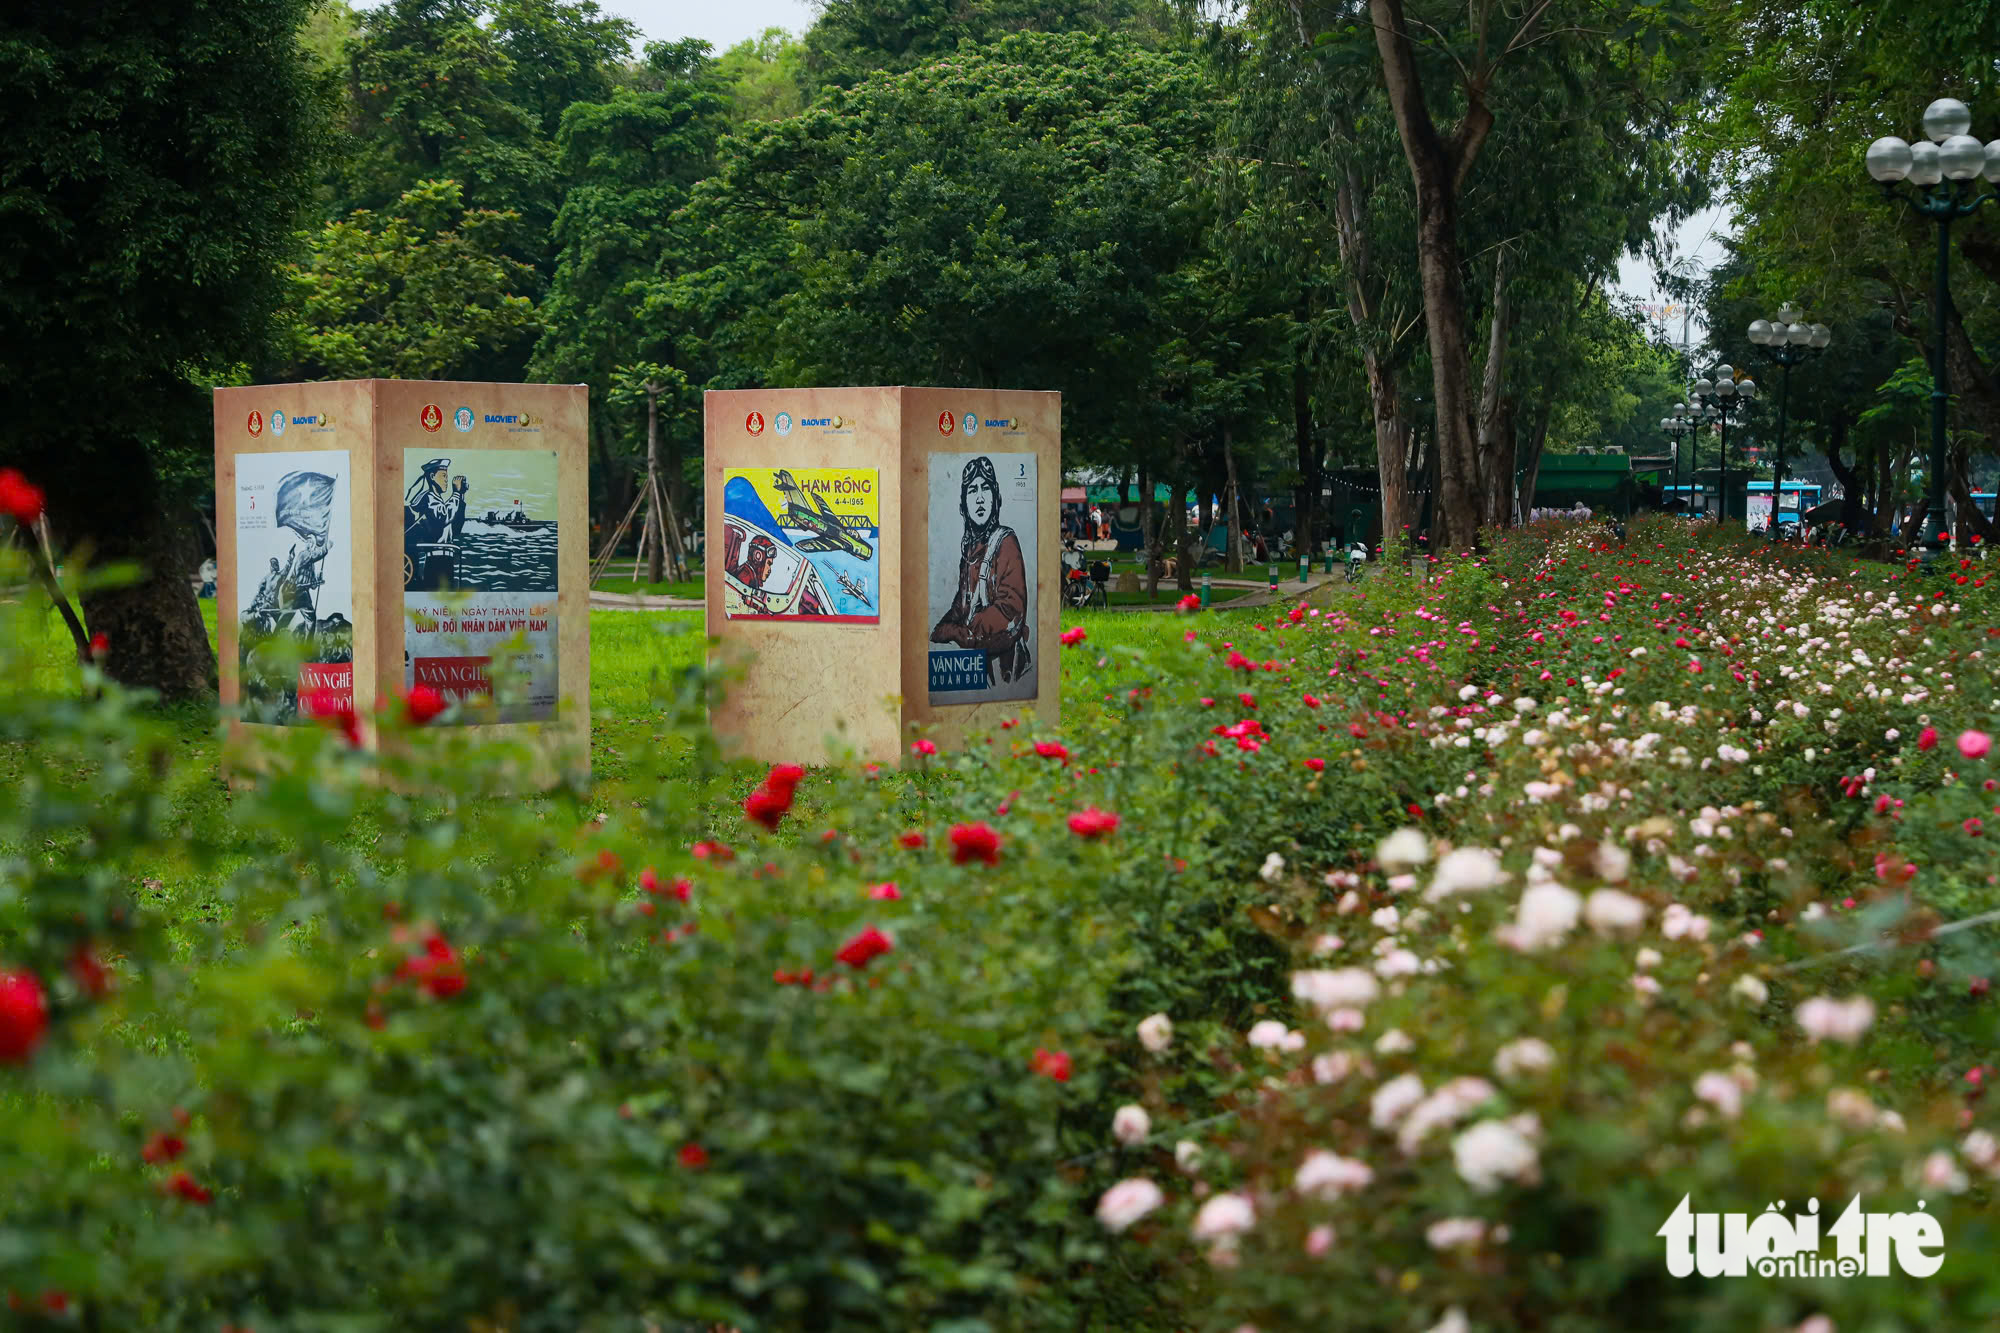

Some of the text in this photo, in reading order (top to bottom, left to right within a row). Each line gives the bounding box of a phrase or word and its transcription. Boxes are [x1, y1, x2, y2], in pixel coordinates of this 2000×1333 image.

[484, 415, 518, 424] BAOVIET
[801, 418, 831, 427] BAOVIET
[461, 618, 485, 633] NHÂN
[529, 619, 548, 632] NAM
[932, 655, 953, 673] VĂN
